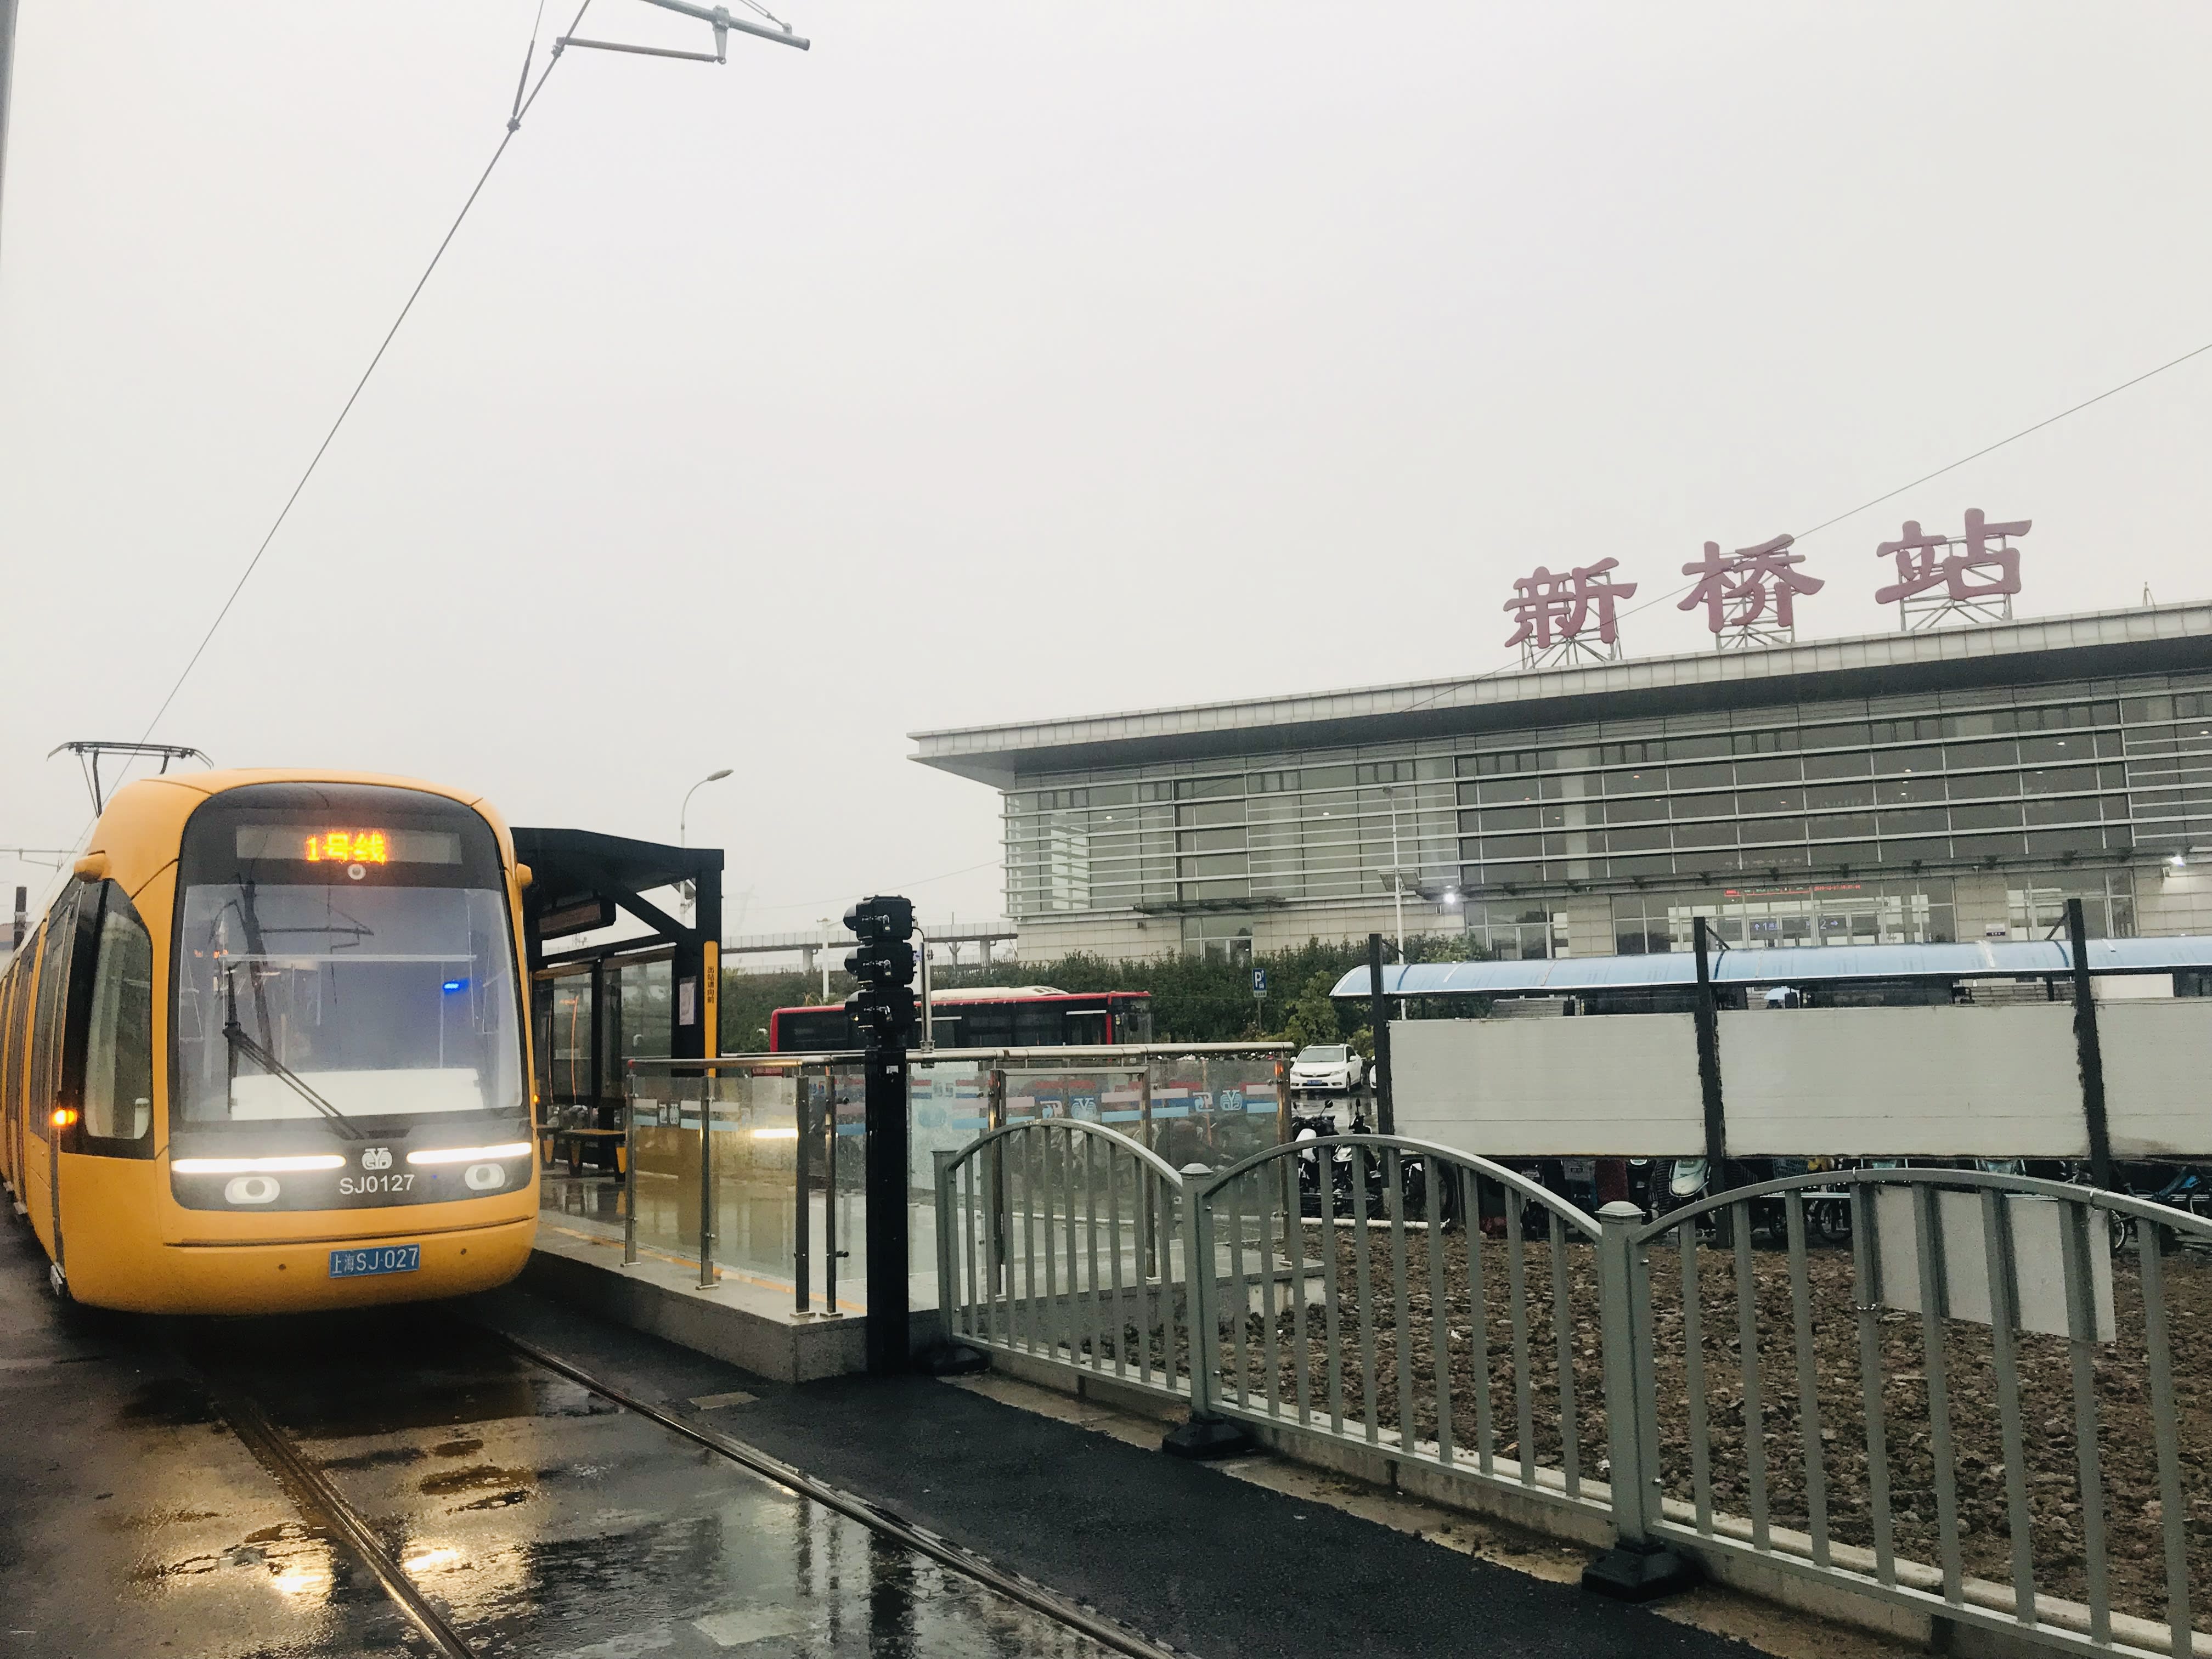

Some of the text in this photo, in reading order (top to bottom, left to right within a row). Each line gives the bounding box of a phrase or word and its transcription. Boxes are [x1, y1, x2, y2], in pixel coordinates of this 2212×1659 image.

[1503, 507, 2032, 648] 新桥站
[306, 832, 387, 864] 1号线
[1255, 972, 1262, 988] P
[339, 1174, 415, 1195] SJ0127
